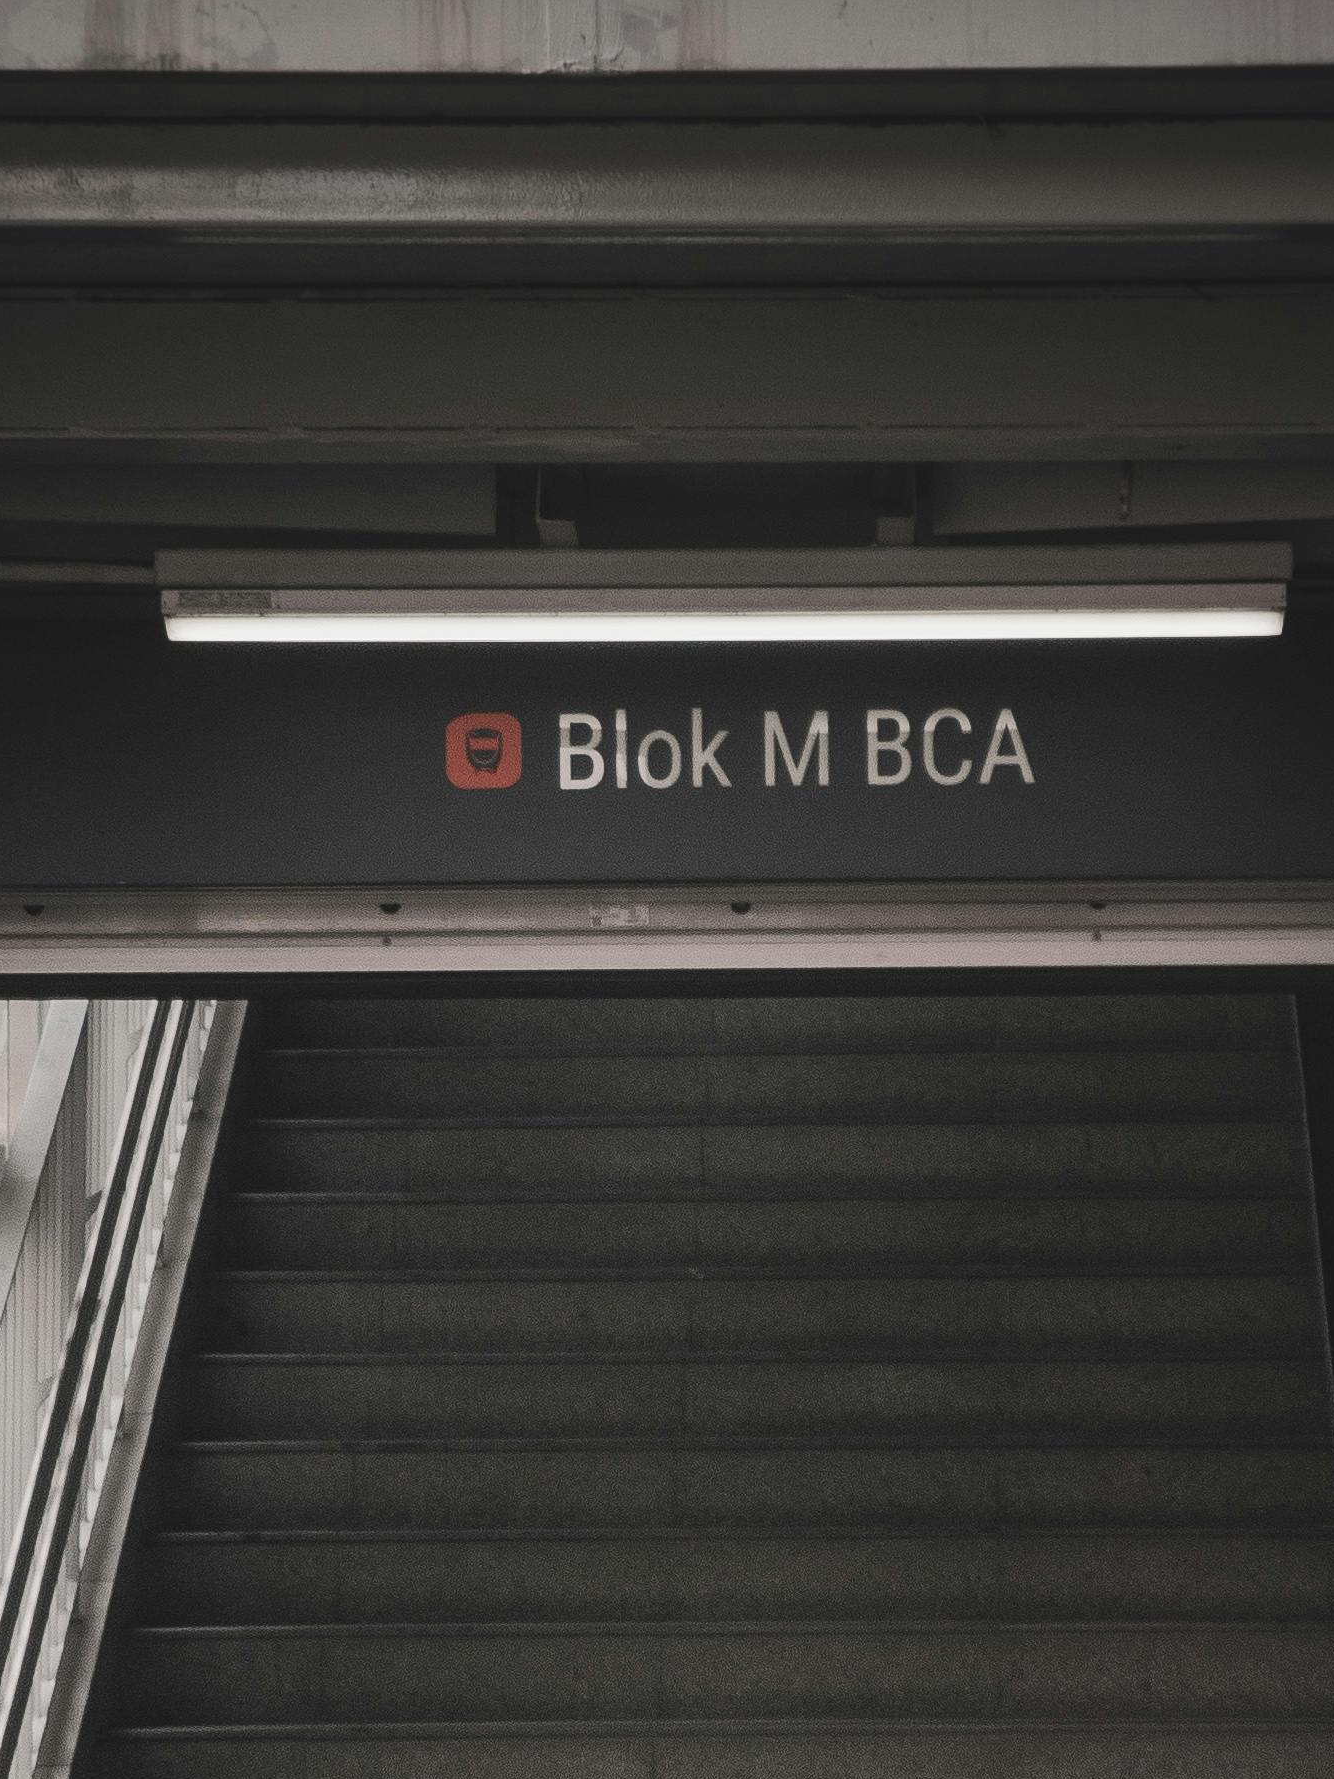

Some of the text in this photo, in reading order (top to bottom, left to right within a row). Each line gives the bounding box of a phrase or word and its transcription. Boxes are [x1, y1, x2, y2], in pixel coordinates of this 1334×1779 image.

[557, 708, 1036, 791] Blok M BCA
